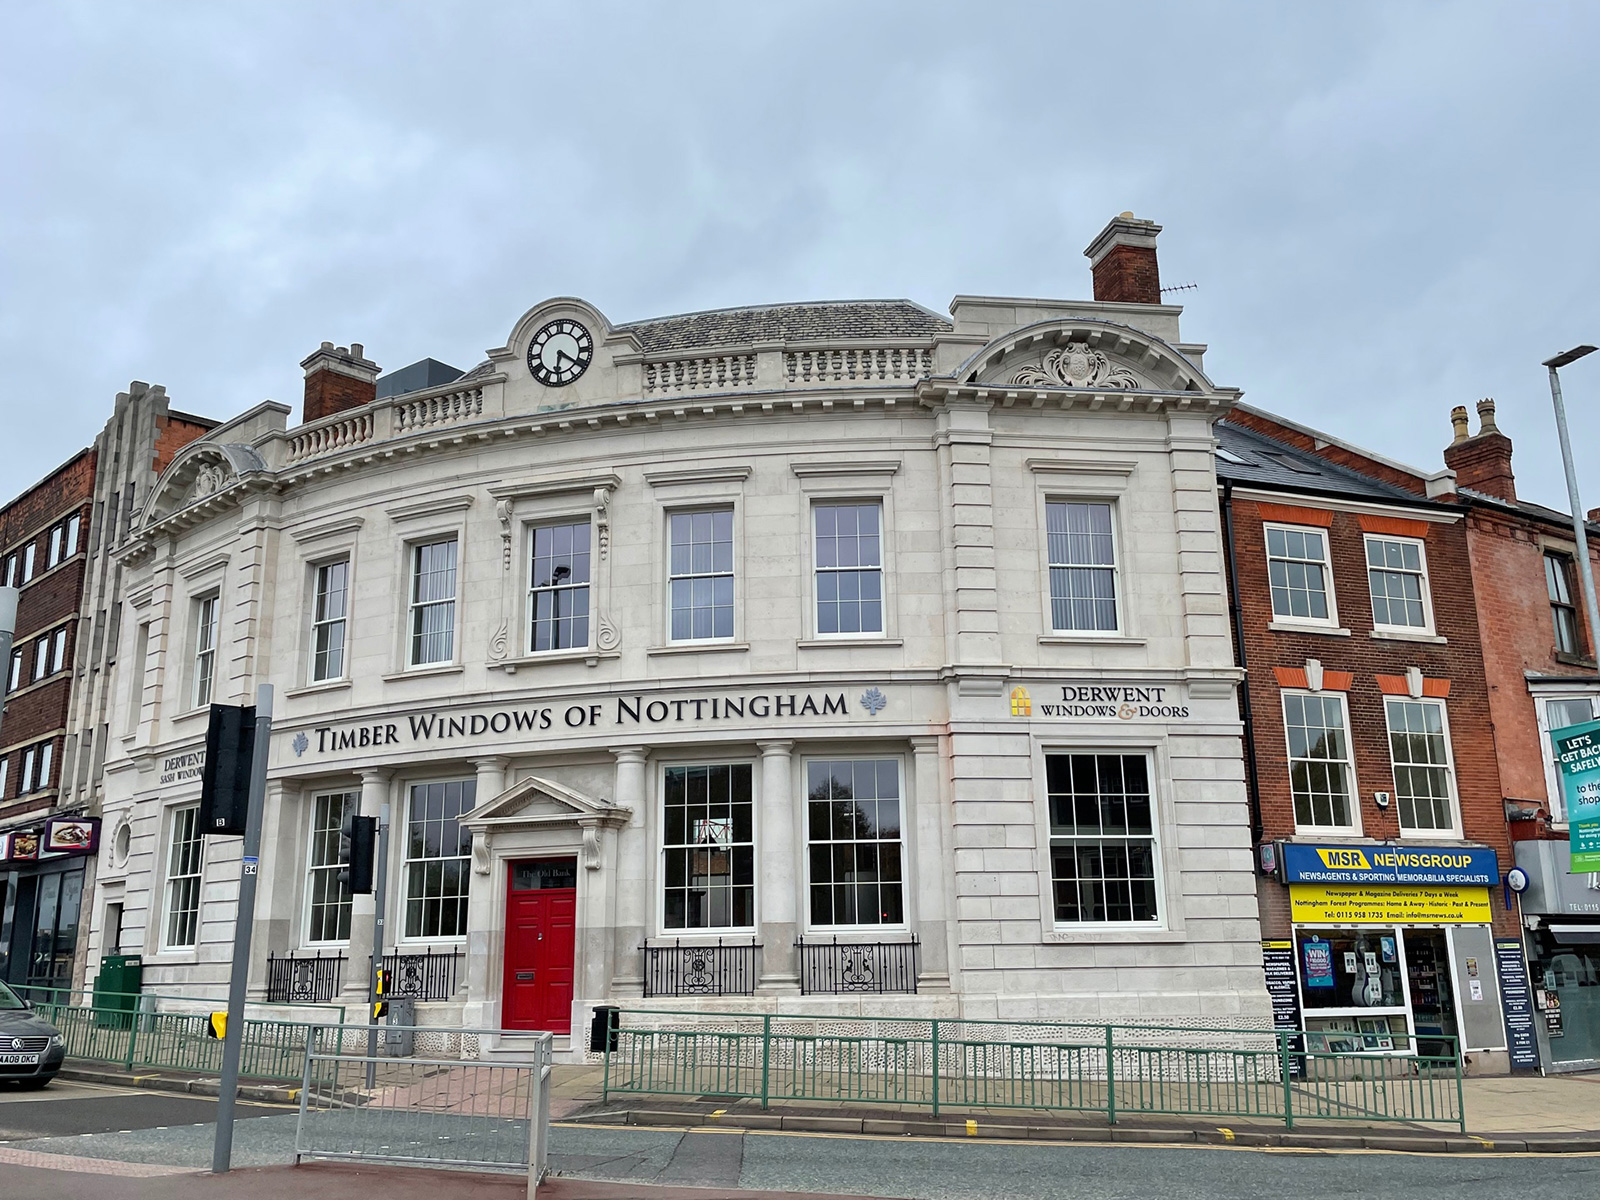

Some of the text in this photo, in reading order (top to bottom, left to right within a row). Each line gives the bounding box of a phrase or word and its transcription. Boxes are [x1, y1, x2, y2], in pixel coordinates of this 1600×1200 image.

[1061, 686, 1166, 702] DERWENT
[1041, 704, 1189, 720] WINDOWS & DOORS
[315, 692, 848, 752] TIMBER WINDOWS OF NOTTINGHAM
[1566, 735, 1592, 750] LET'S
[164, 750, 206, 772] DERWENT
[1561, 750, 1578, 763] GET
[160, 772, 175, 784] SASH
[1576, 785, 1586, 794] to
[1328, 852, 1472, 868] MSR NEWSGROUP
[1300, 872, 1350, 880] NEWSAGENTS
[1359, 873, 1395, 881] SPORTING
[1398, 874, 1445, 882] MEMORABILIA
[1446, 874, 1489, 882] SPECIALISTS
[1326, 890, 1358, 898] Newspaper
[1309, 950, 1326, 958] WIN
